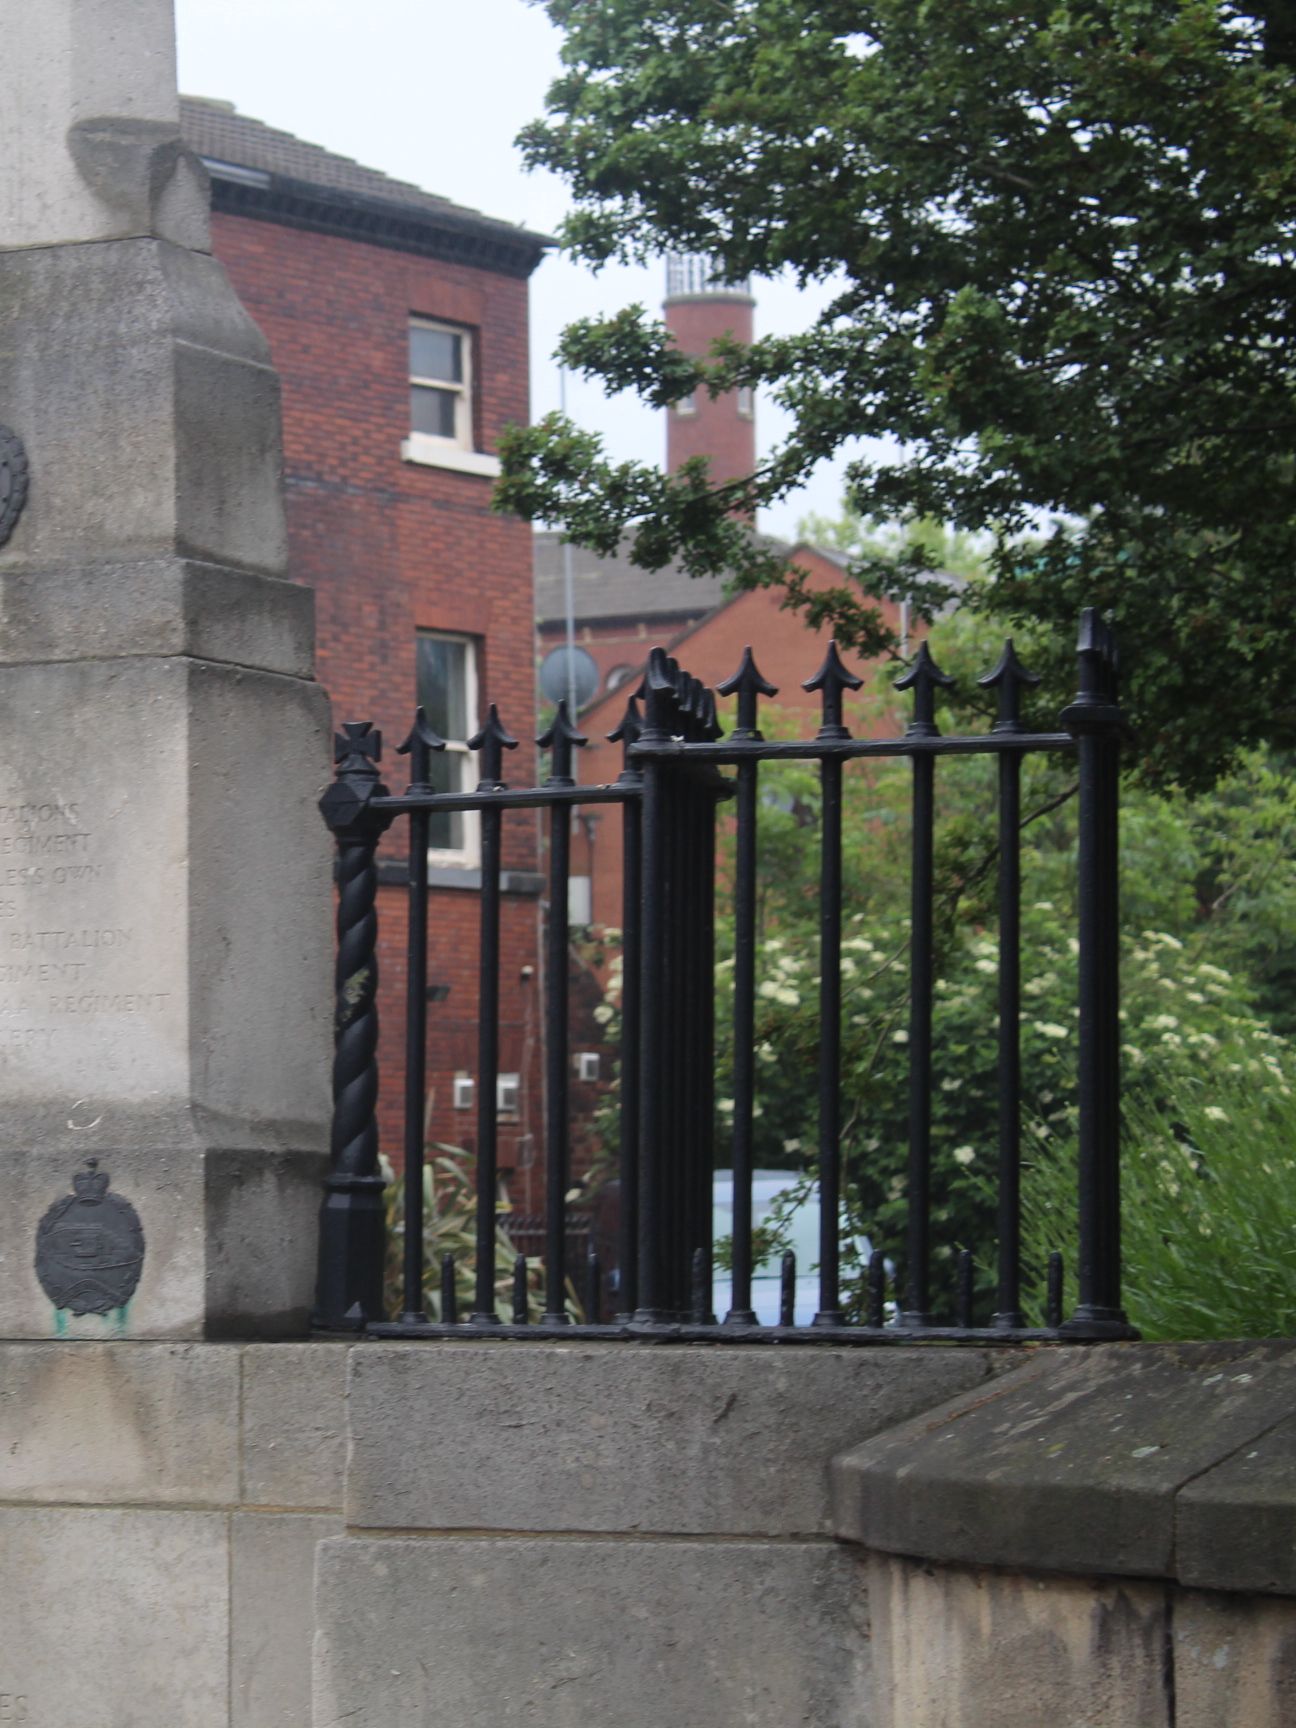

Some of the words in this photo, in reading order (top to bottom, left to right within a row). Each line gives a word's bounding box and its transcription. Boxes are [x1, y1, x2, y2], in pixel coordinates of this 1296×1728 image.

[51, 864, 105, 885] OWN
[8, 927, 134, 951] BATTALION
[47, 991, 172, 1015] REGIMENT
